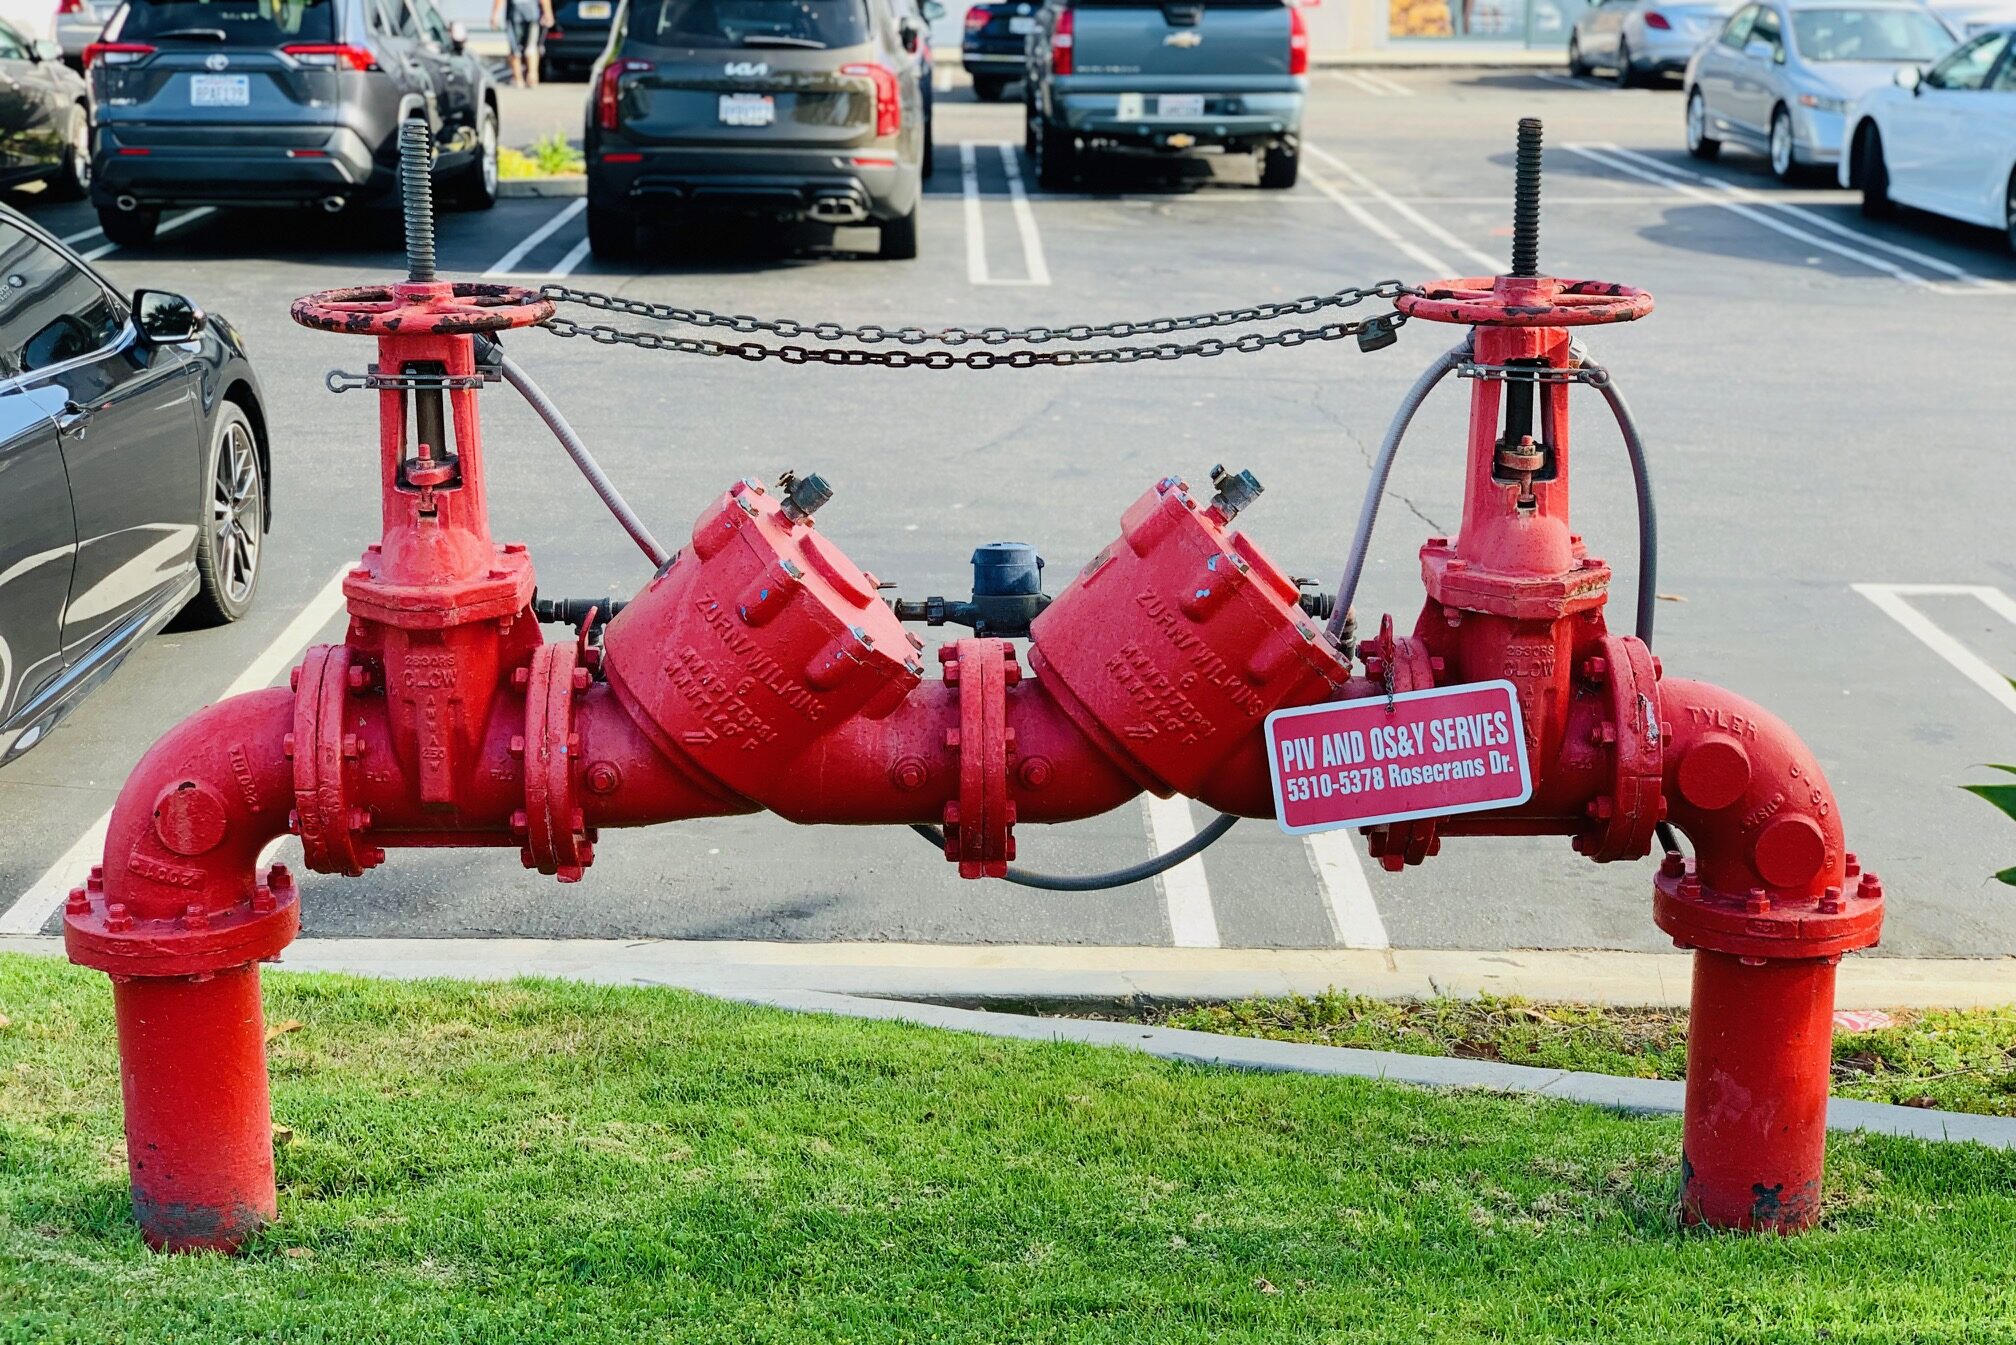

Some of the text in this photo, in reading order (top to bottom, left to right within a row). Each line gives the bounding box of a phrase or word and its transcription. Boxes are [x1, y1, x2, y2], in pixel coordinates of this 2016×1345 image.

[1280, 710, 1509, 773] PIV AND OS&Y SERVES
[1686, 706, 1758, 740] TYLER
[1287, 750, 1515, 802] 5310-5378 Rosecrans Dr.
